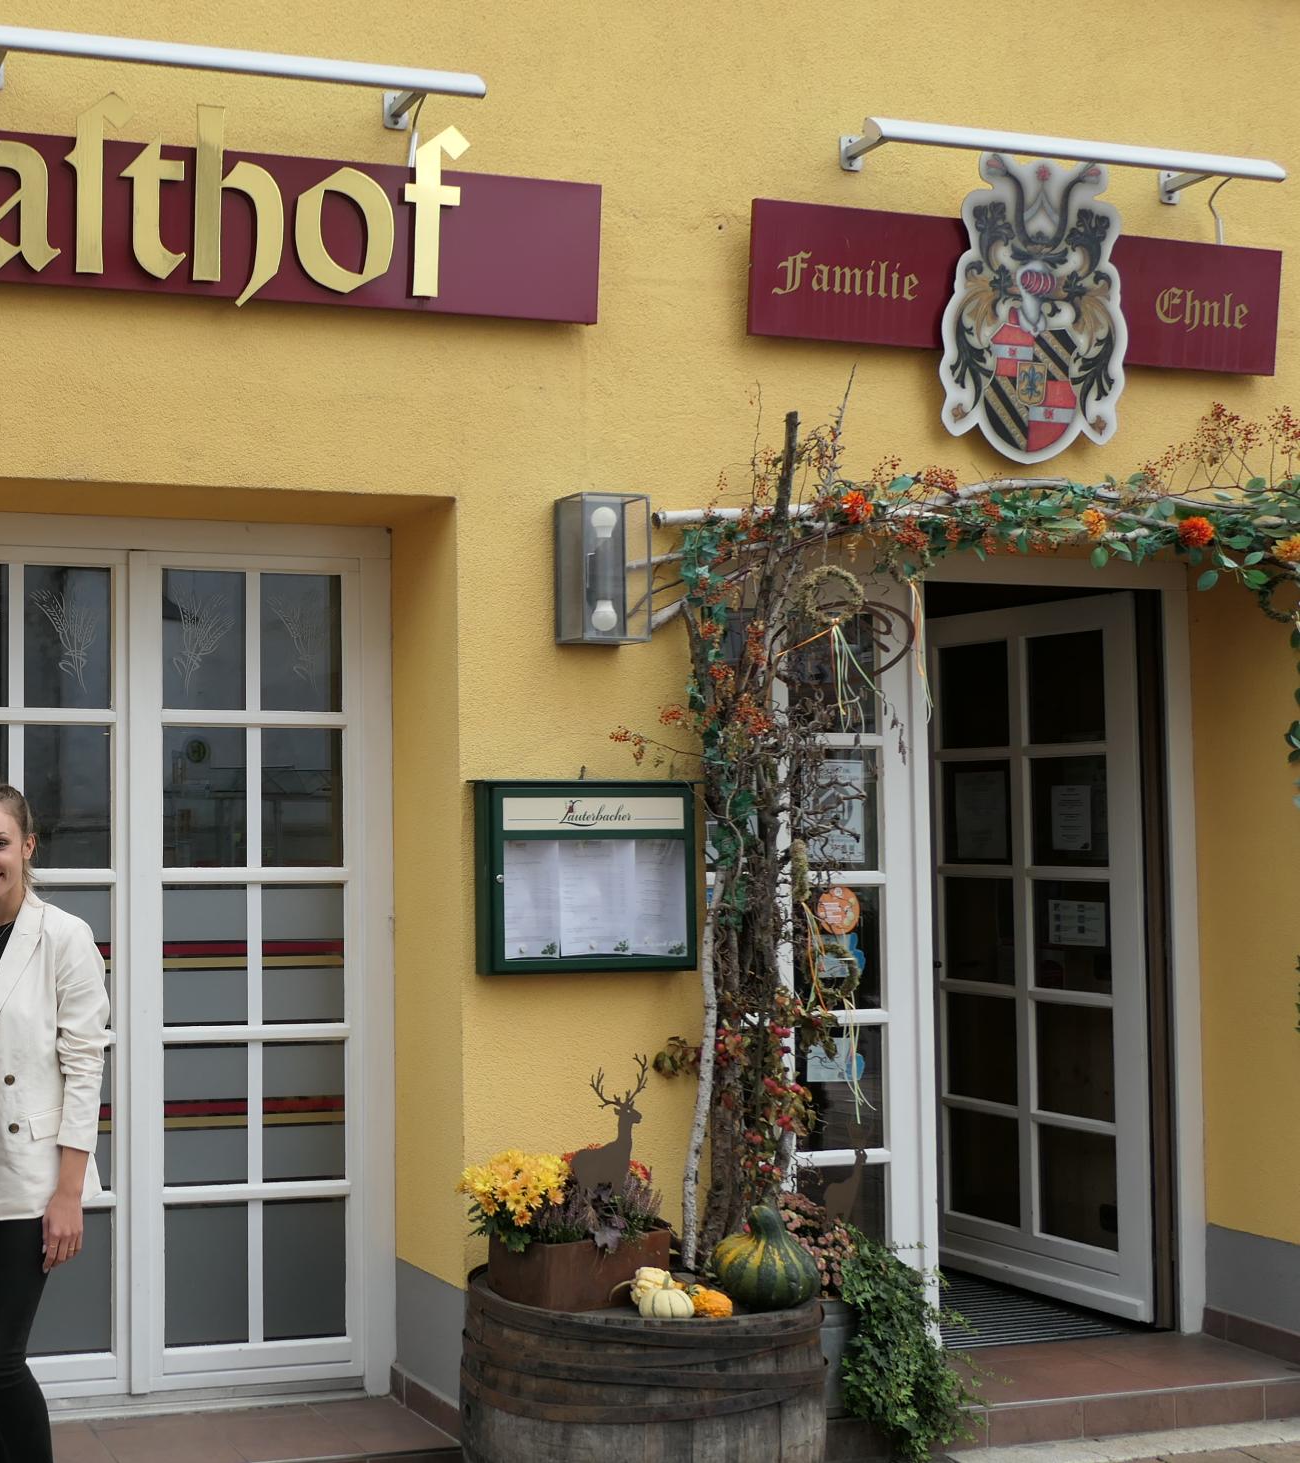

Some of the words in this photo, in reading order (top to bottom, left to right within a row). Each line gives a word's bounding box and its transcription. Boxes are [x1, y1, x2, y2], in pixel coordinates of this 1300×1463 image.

[771, 250, 920, 301] Familie
[1155, 286, 1250, 333] Ehnle
[558, 799, 633, 827] Lauterbacher
